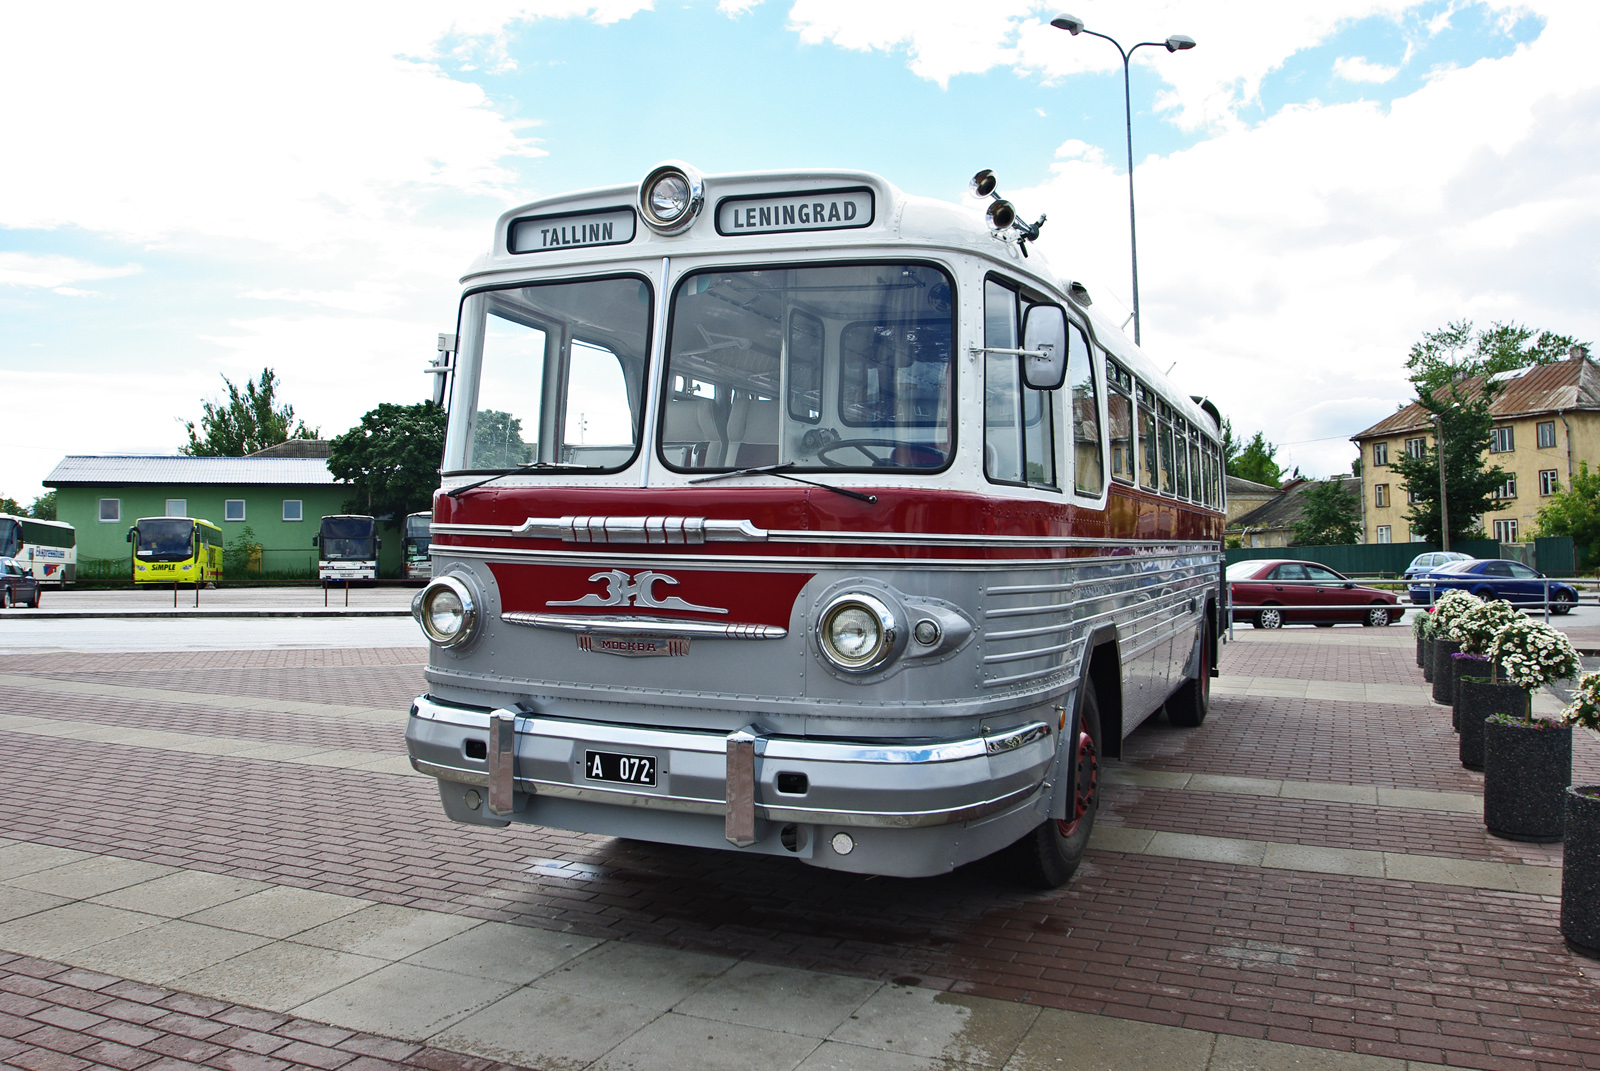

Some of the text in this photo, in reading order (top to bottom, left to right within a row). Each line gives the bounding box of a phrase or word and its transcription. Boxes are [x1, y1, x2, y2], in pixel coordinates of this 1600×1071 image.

[733, 201, 857, 228] LENINGRAD
[540, 222, 613, 247] TALLINN
[601, 640, 657, 651] МОСКВА
[591, 754, 650, 782] A 072
